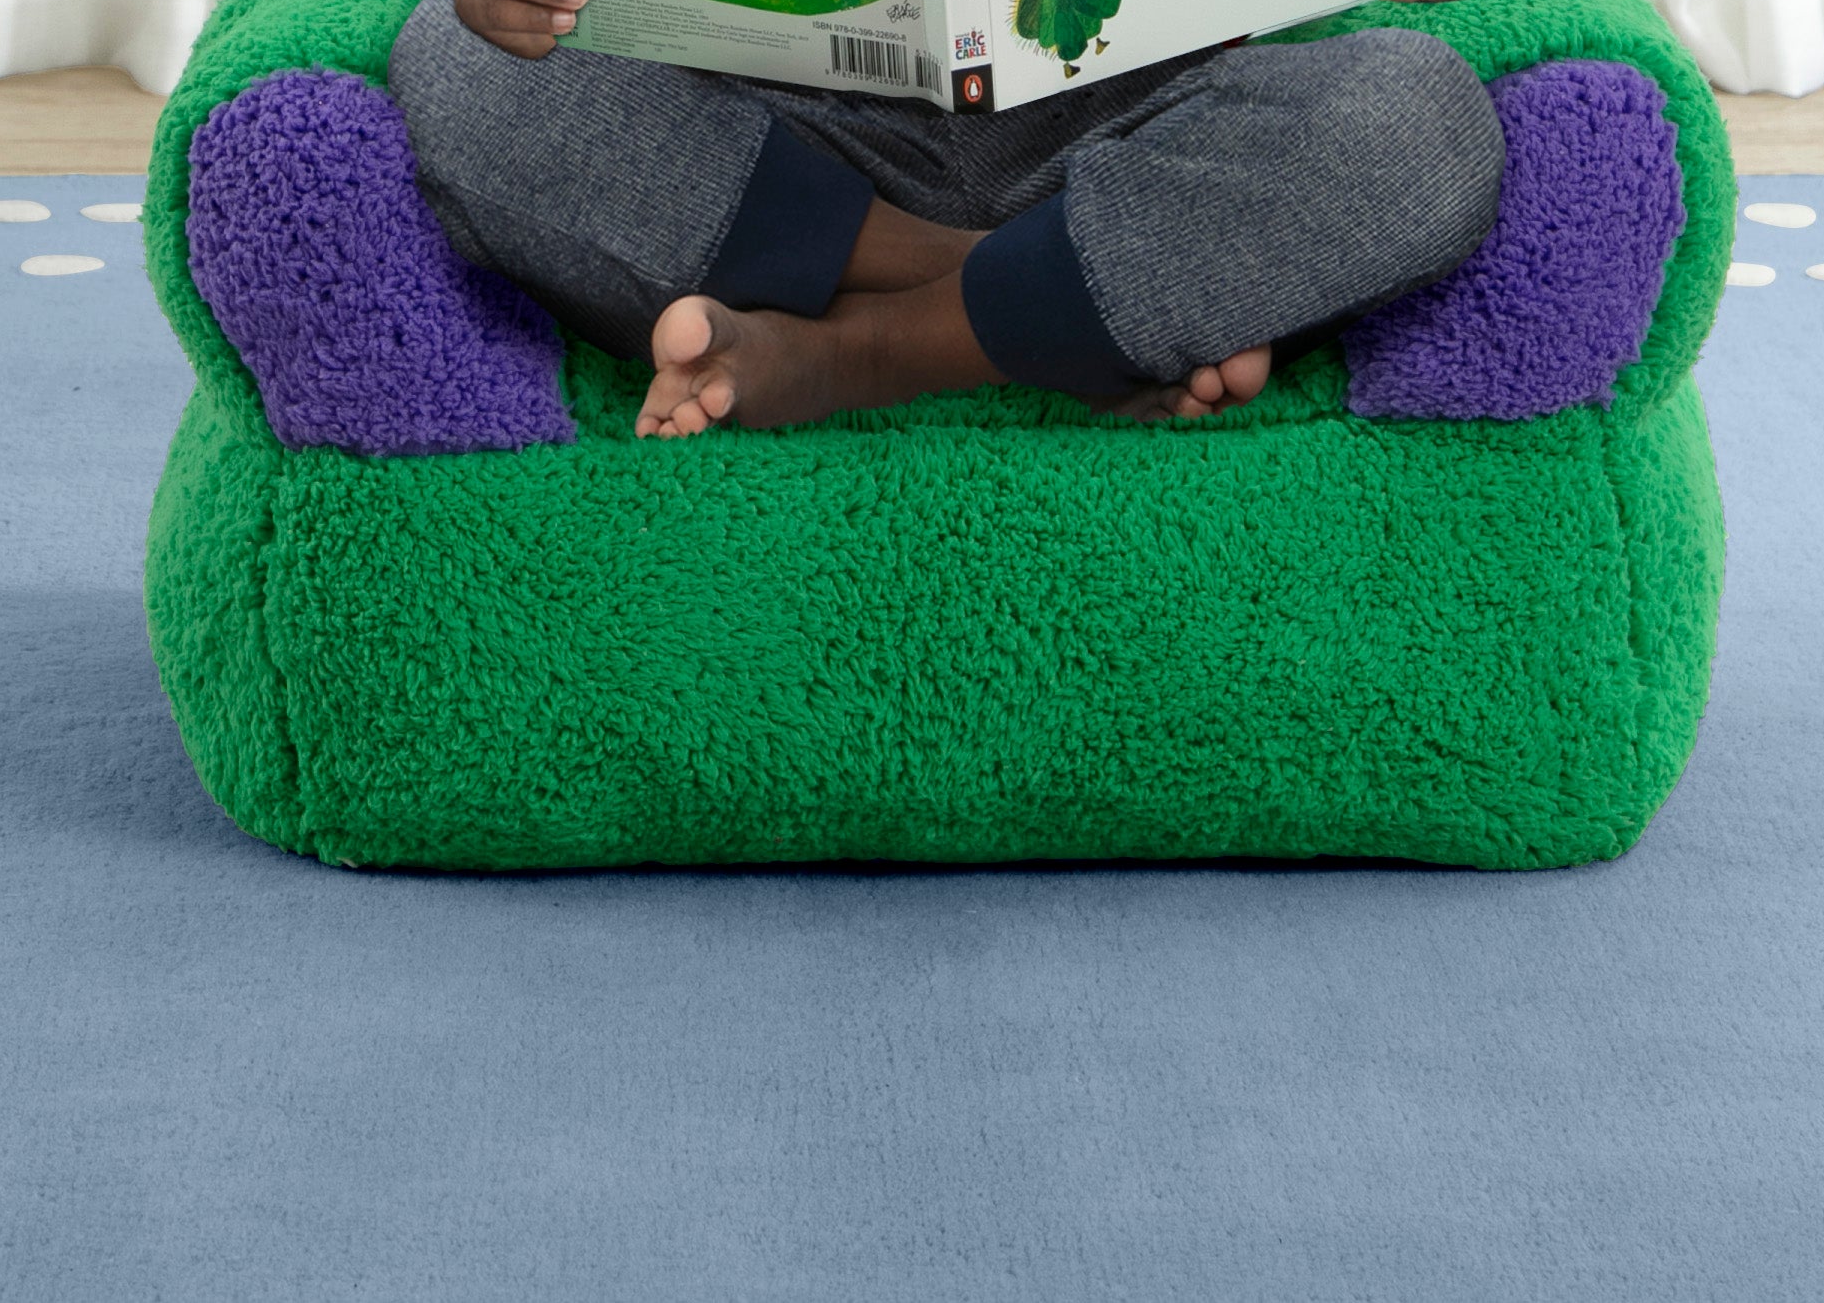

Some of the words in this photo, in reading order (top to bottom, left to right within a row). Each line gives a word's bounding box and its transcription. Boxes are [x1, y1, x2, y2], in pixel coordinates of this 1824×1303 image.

[812, 21, 832, 31] ISBN
[955, 32, 985, 50] ERIC
[955, 45, 986, 60] CARLE
